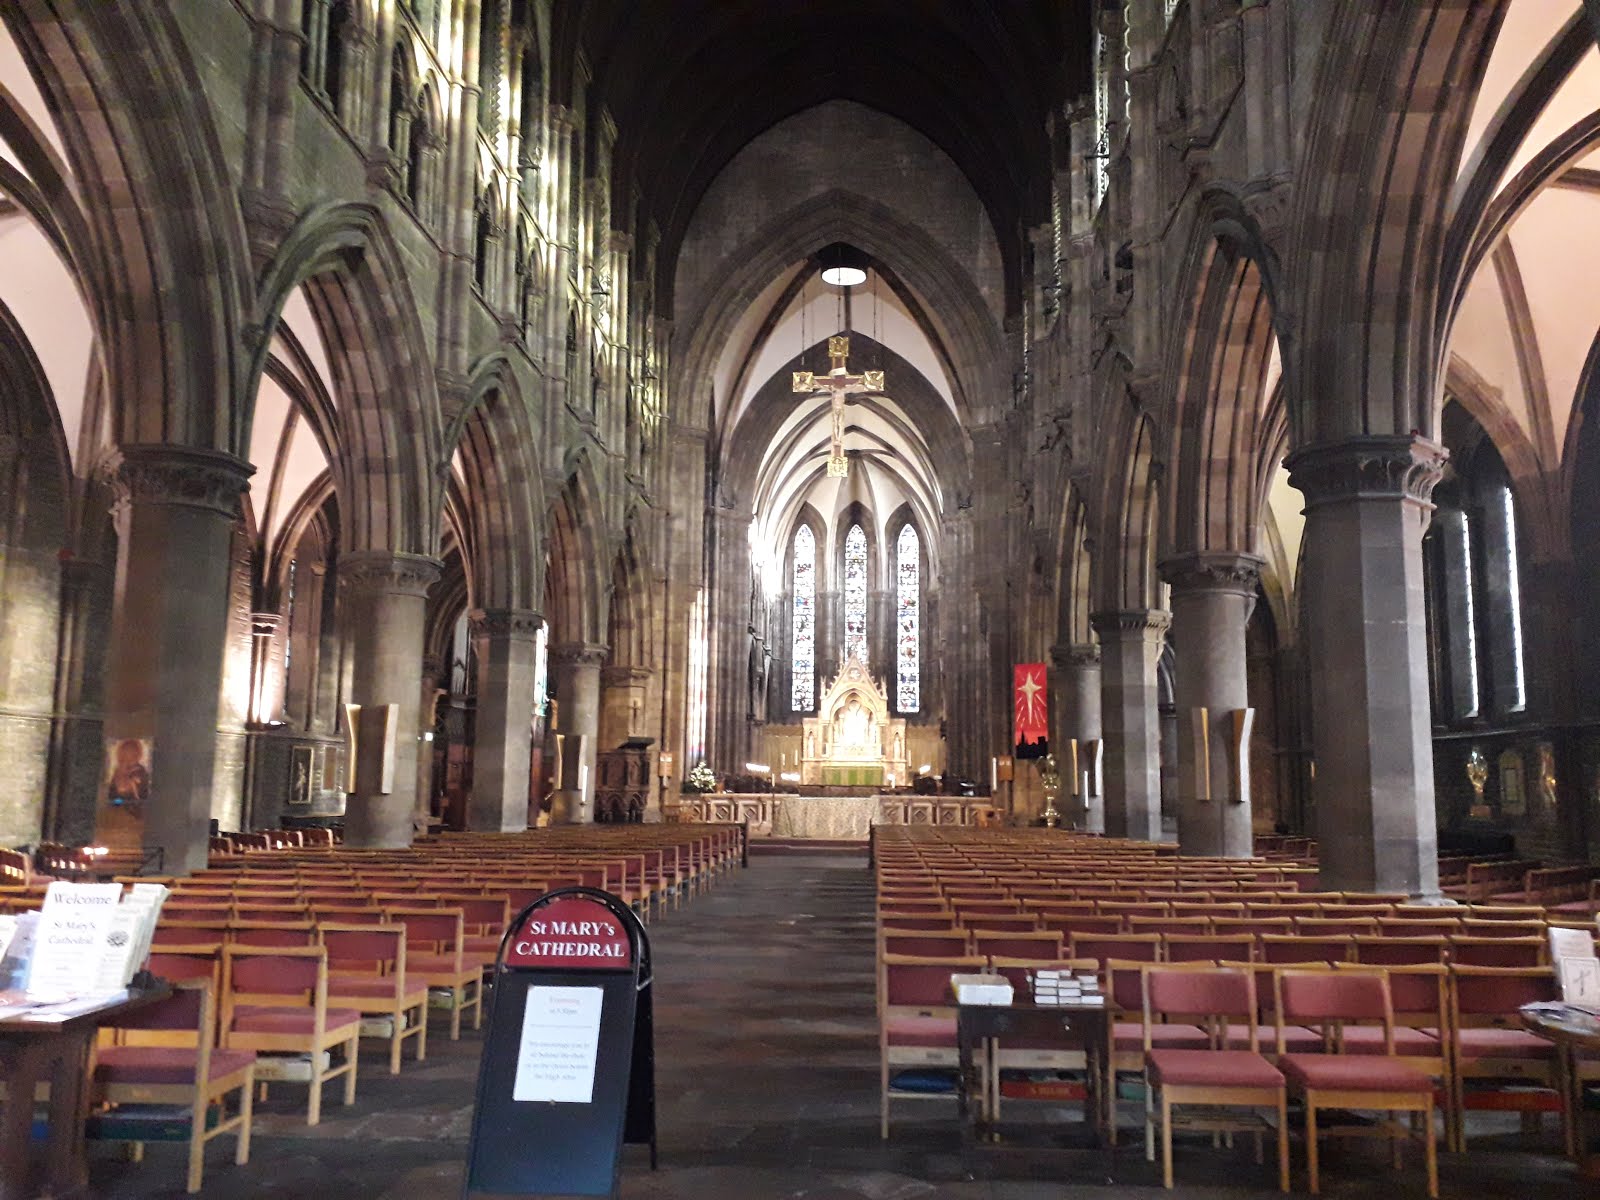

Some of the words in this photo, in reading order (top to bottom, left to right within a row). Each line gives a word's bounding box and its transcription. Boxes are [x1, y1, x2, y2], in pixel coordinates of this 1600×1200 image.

[54, 892, 113, 905] Welcome
[530, 921, 547, 935] St
[550, 921, 615, 937] MARY's
[515, 941, 625, 957] CATHEDRAL
